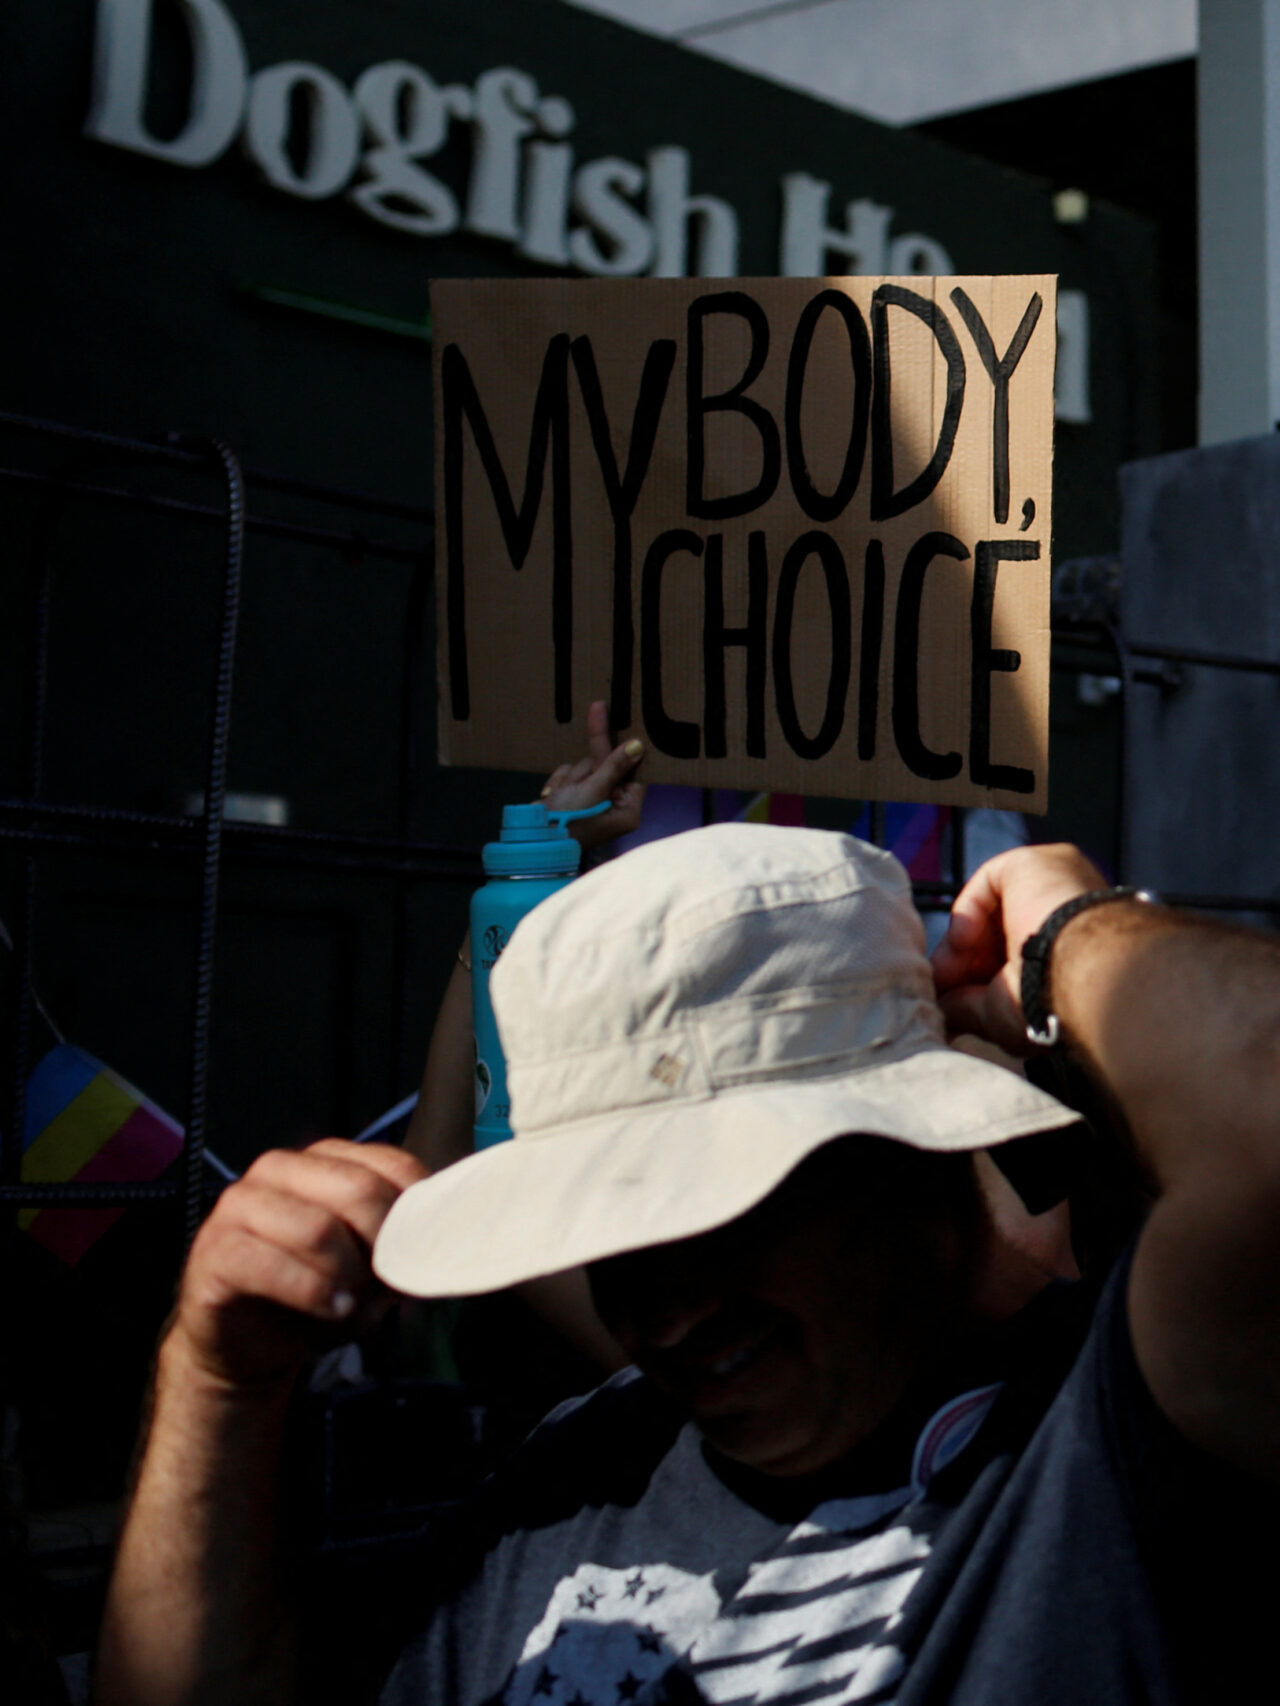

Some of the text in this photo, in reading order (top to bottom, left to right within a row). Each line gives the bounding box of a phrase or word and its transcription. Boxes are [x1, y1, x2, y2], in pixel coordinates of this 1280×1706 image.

[82, 0, 740, 279] Dogfish
[442, 284, 1043, 732] MY BODY,
[641, 529, 1041, 794] CHOICE
